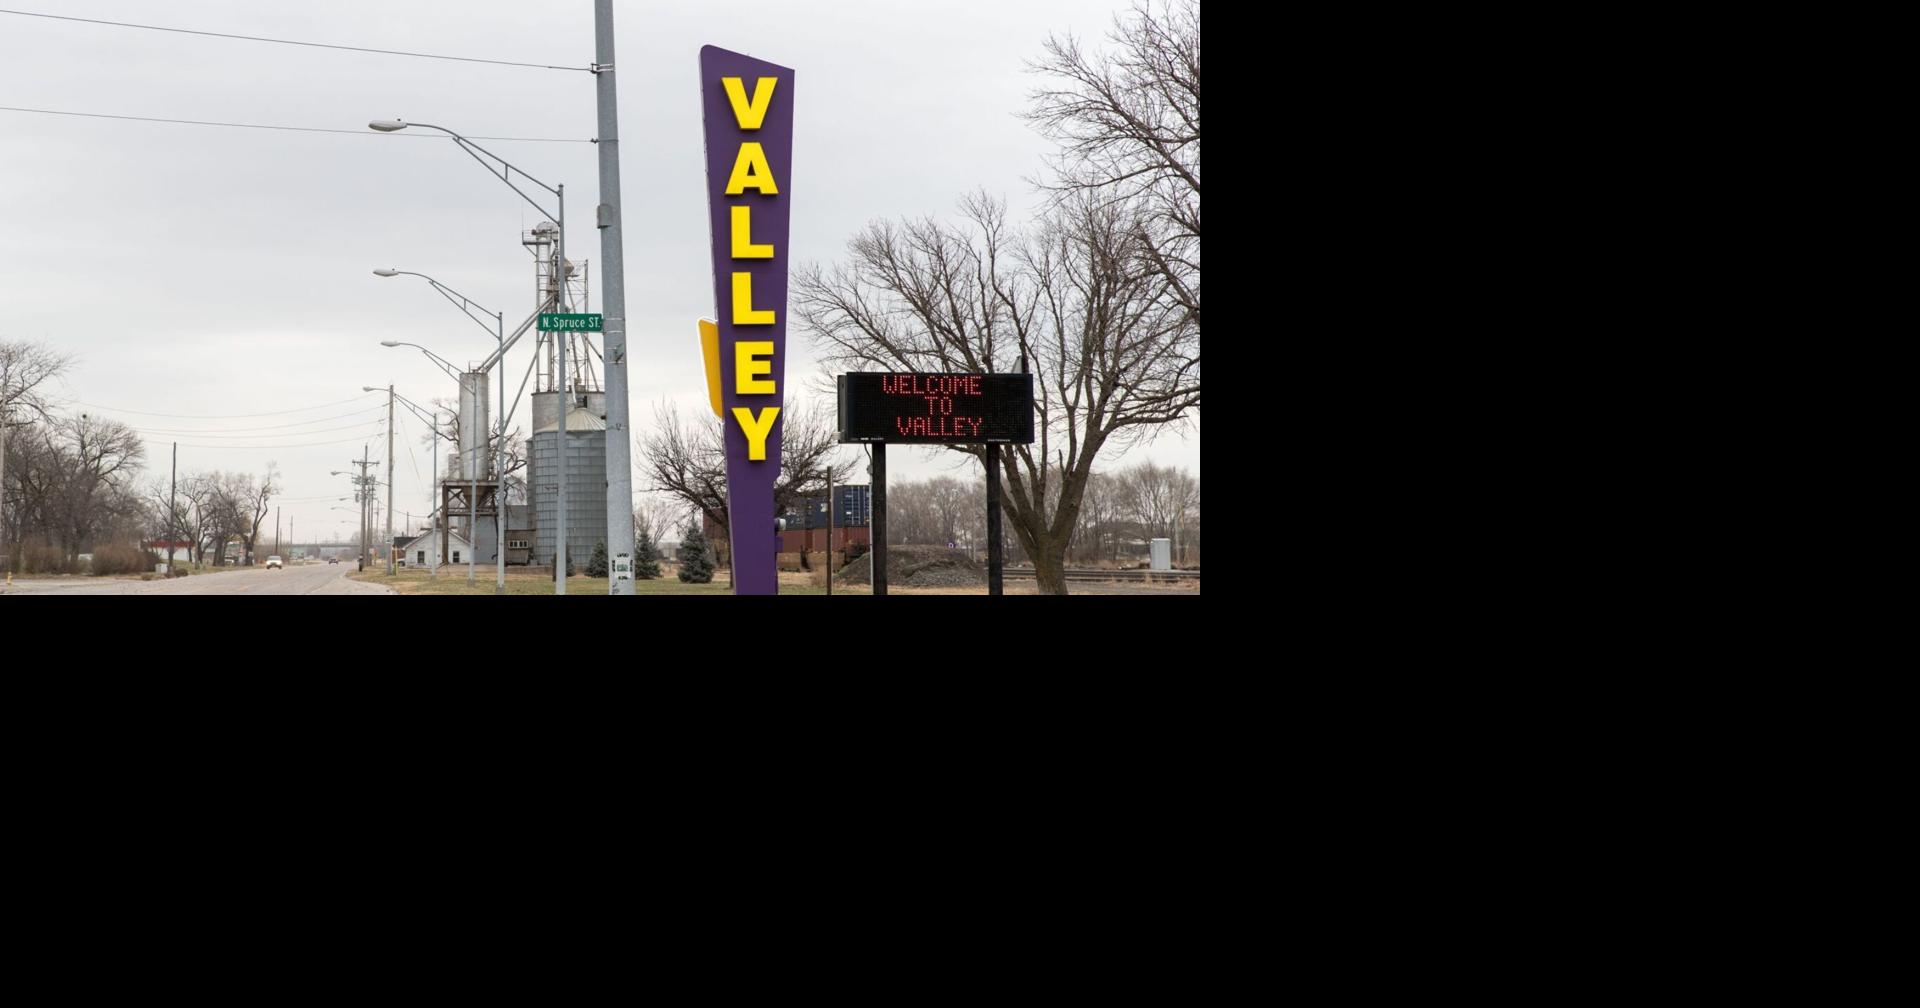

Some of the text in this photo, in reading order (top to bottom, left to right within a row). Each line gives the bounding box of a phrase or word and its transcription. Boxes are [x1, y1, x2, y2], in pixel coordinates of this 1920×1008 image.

[721, 76, 781, 461] VALLEY
[543, 317, 601, 329] N. Spruce ST.
[882, 375, 982, 395] WELCOME
[924, 396, 953, 415] TO
[897, 417, 983, 436] VALLEY
